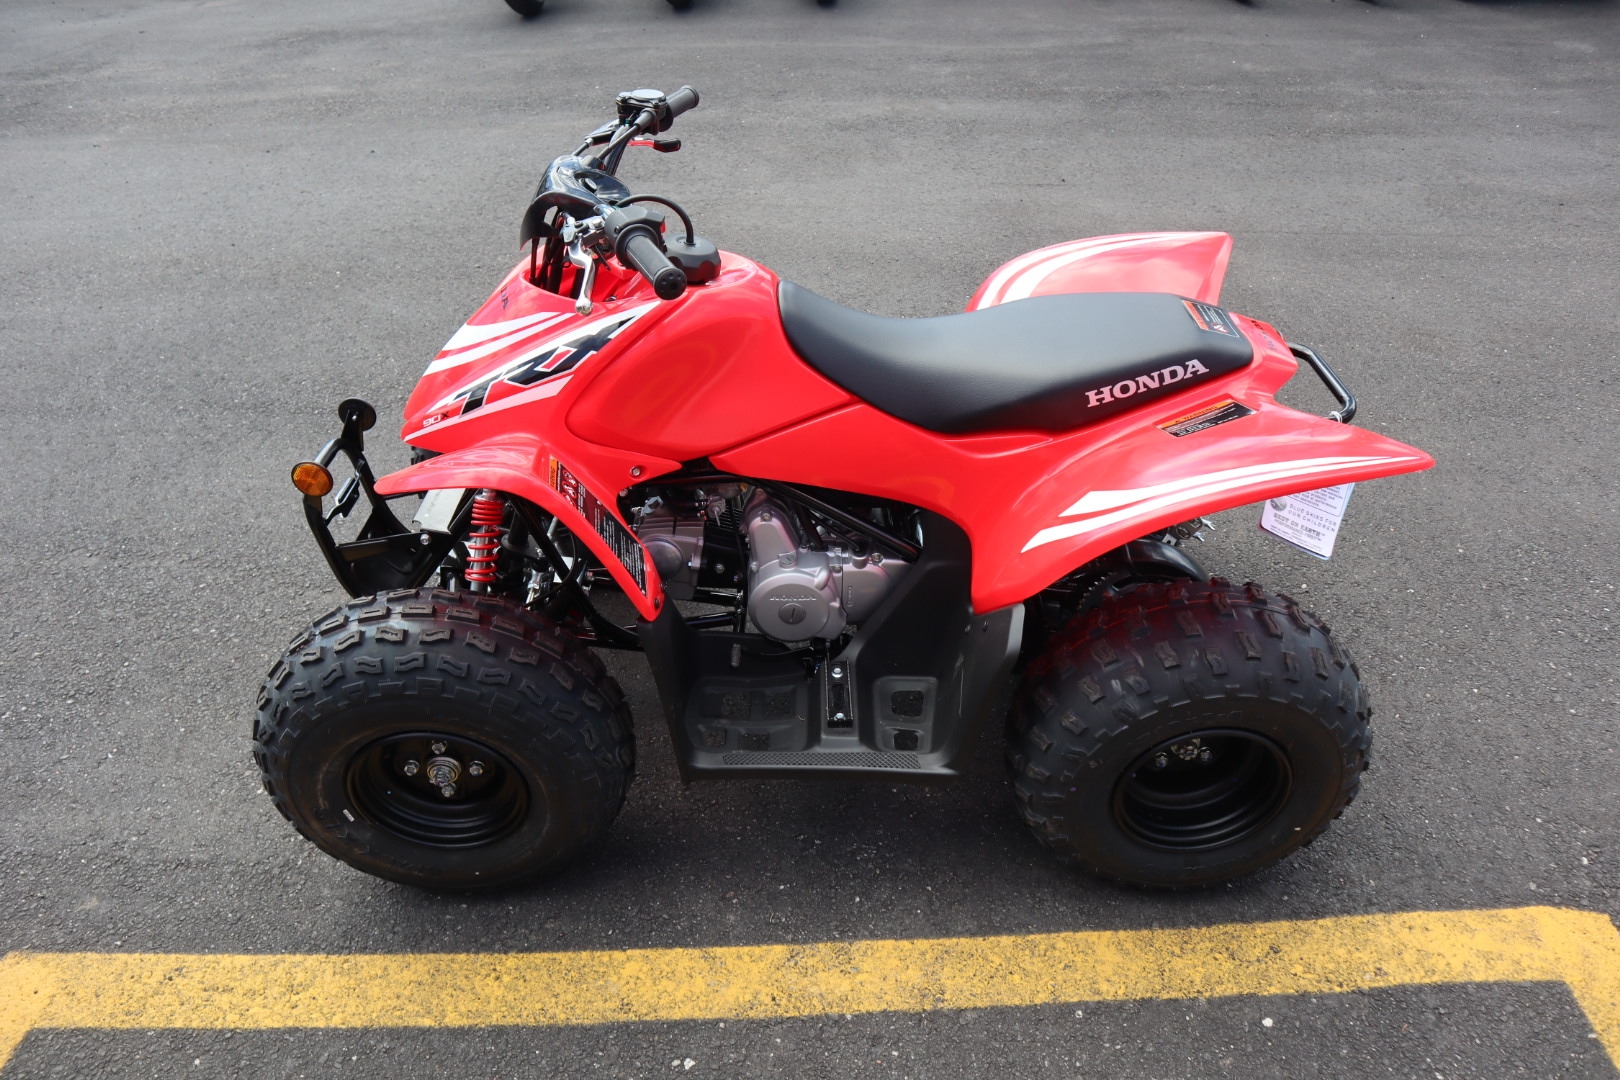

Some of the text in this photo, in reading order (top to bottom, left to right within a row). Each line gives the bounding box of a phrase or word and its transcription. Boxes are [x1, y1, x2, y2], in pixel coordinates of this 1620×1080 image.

[1085, 359, 1209, 408] HONDA
[1288, 509, 1336, 533] OUR CHILDREN
[1289, 503, 1337, 526] BLUE SKIES FOR
[769, 593, 817, 602] HONDA
